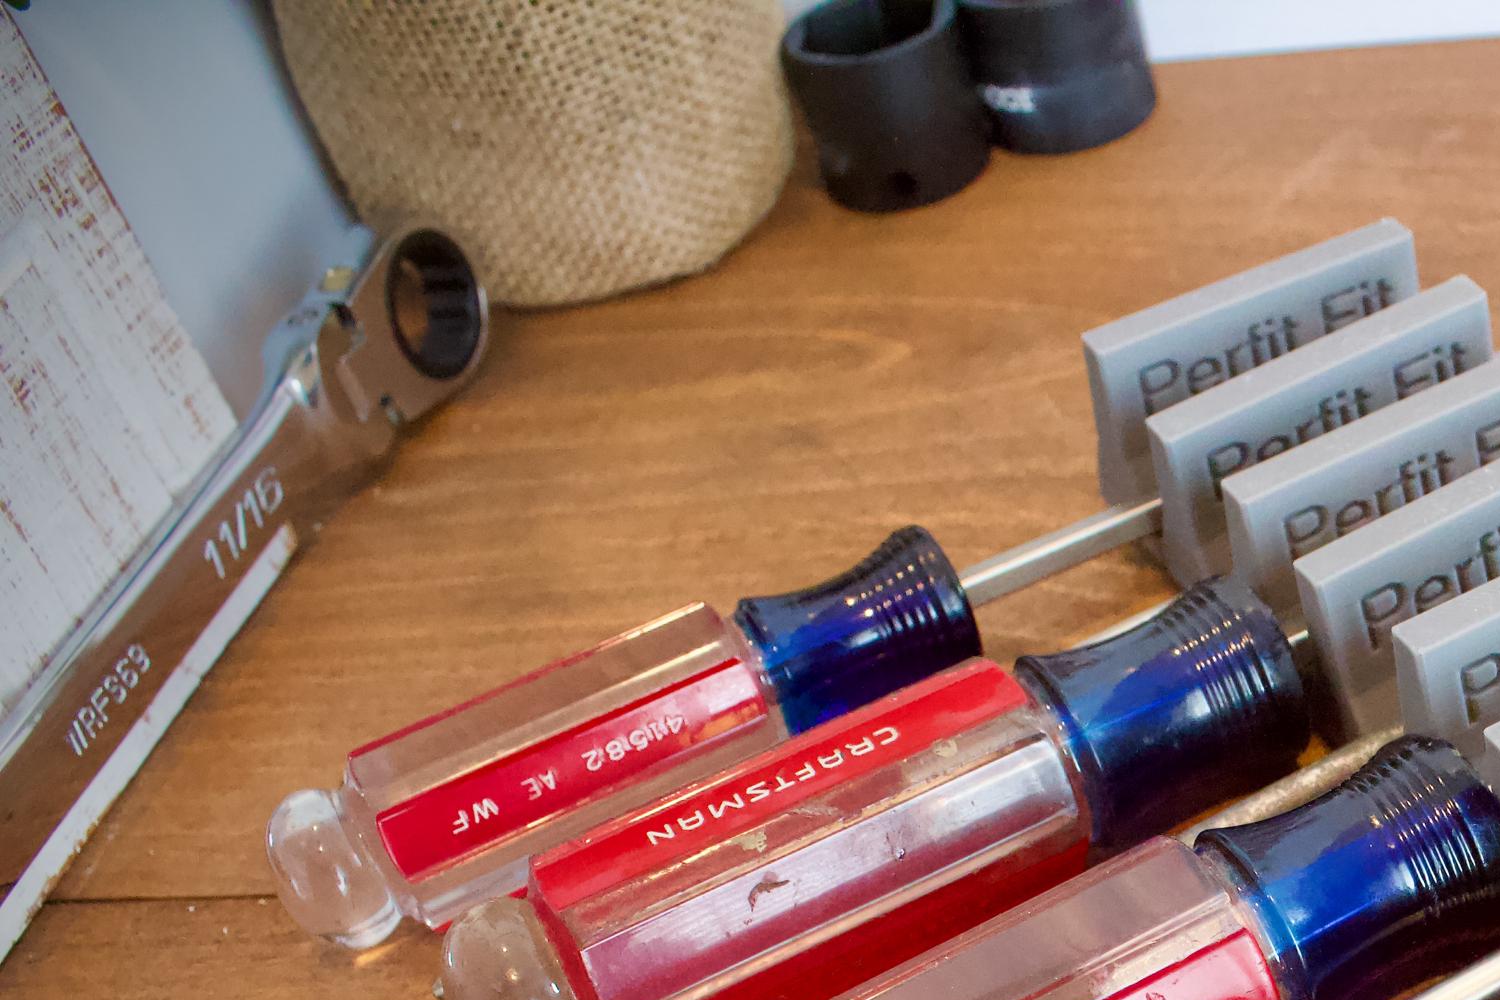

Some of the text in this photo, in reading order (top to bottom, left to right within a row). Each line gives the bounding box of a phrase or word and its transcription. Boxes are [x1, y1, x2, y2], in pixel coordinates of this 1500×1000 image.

[1139, 278, 1395, 417] Perfit Fit
[1393, 342, 1466, 401] Fit
[204, 466, 285, 579] 11/16
[1284, 448, 1454, 563] Perfit
[452, 713, 687, 835] 41582 AE WF
[646, 725, 901, 846] CRAFTSMAN
